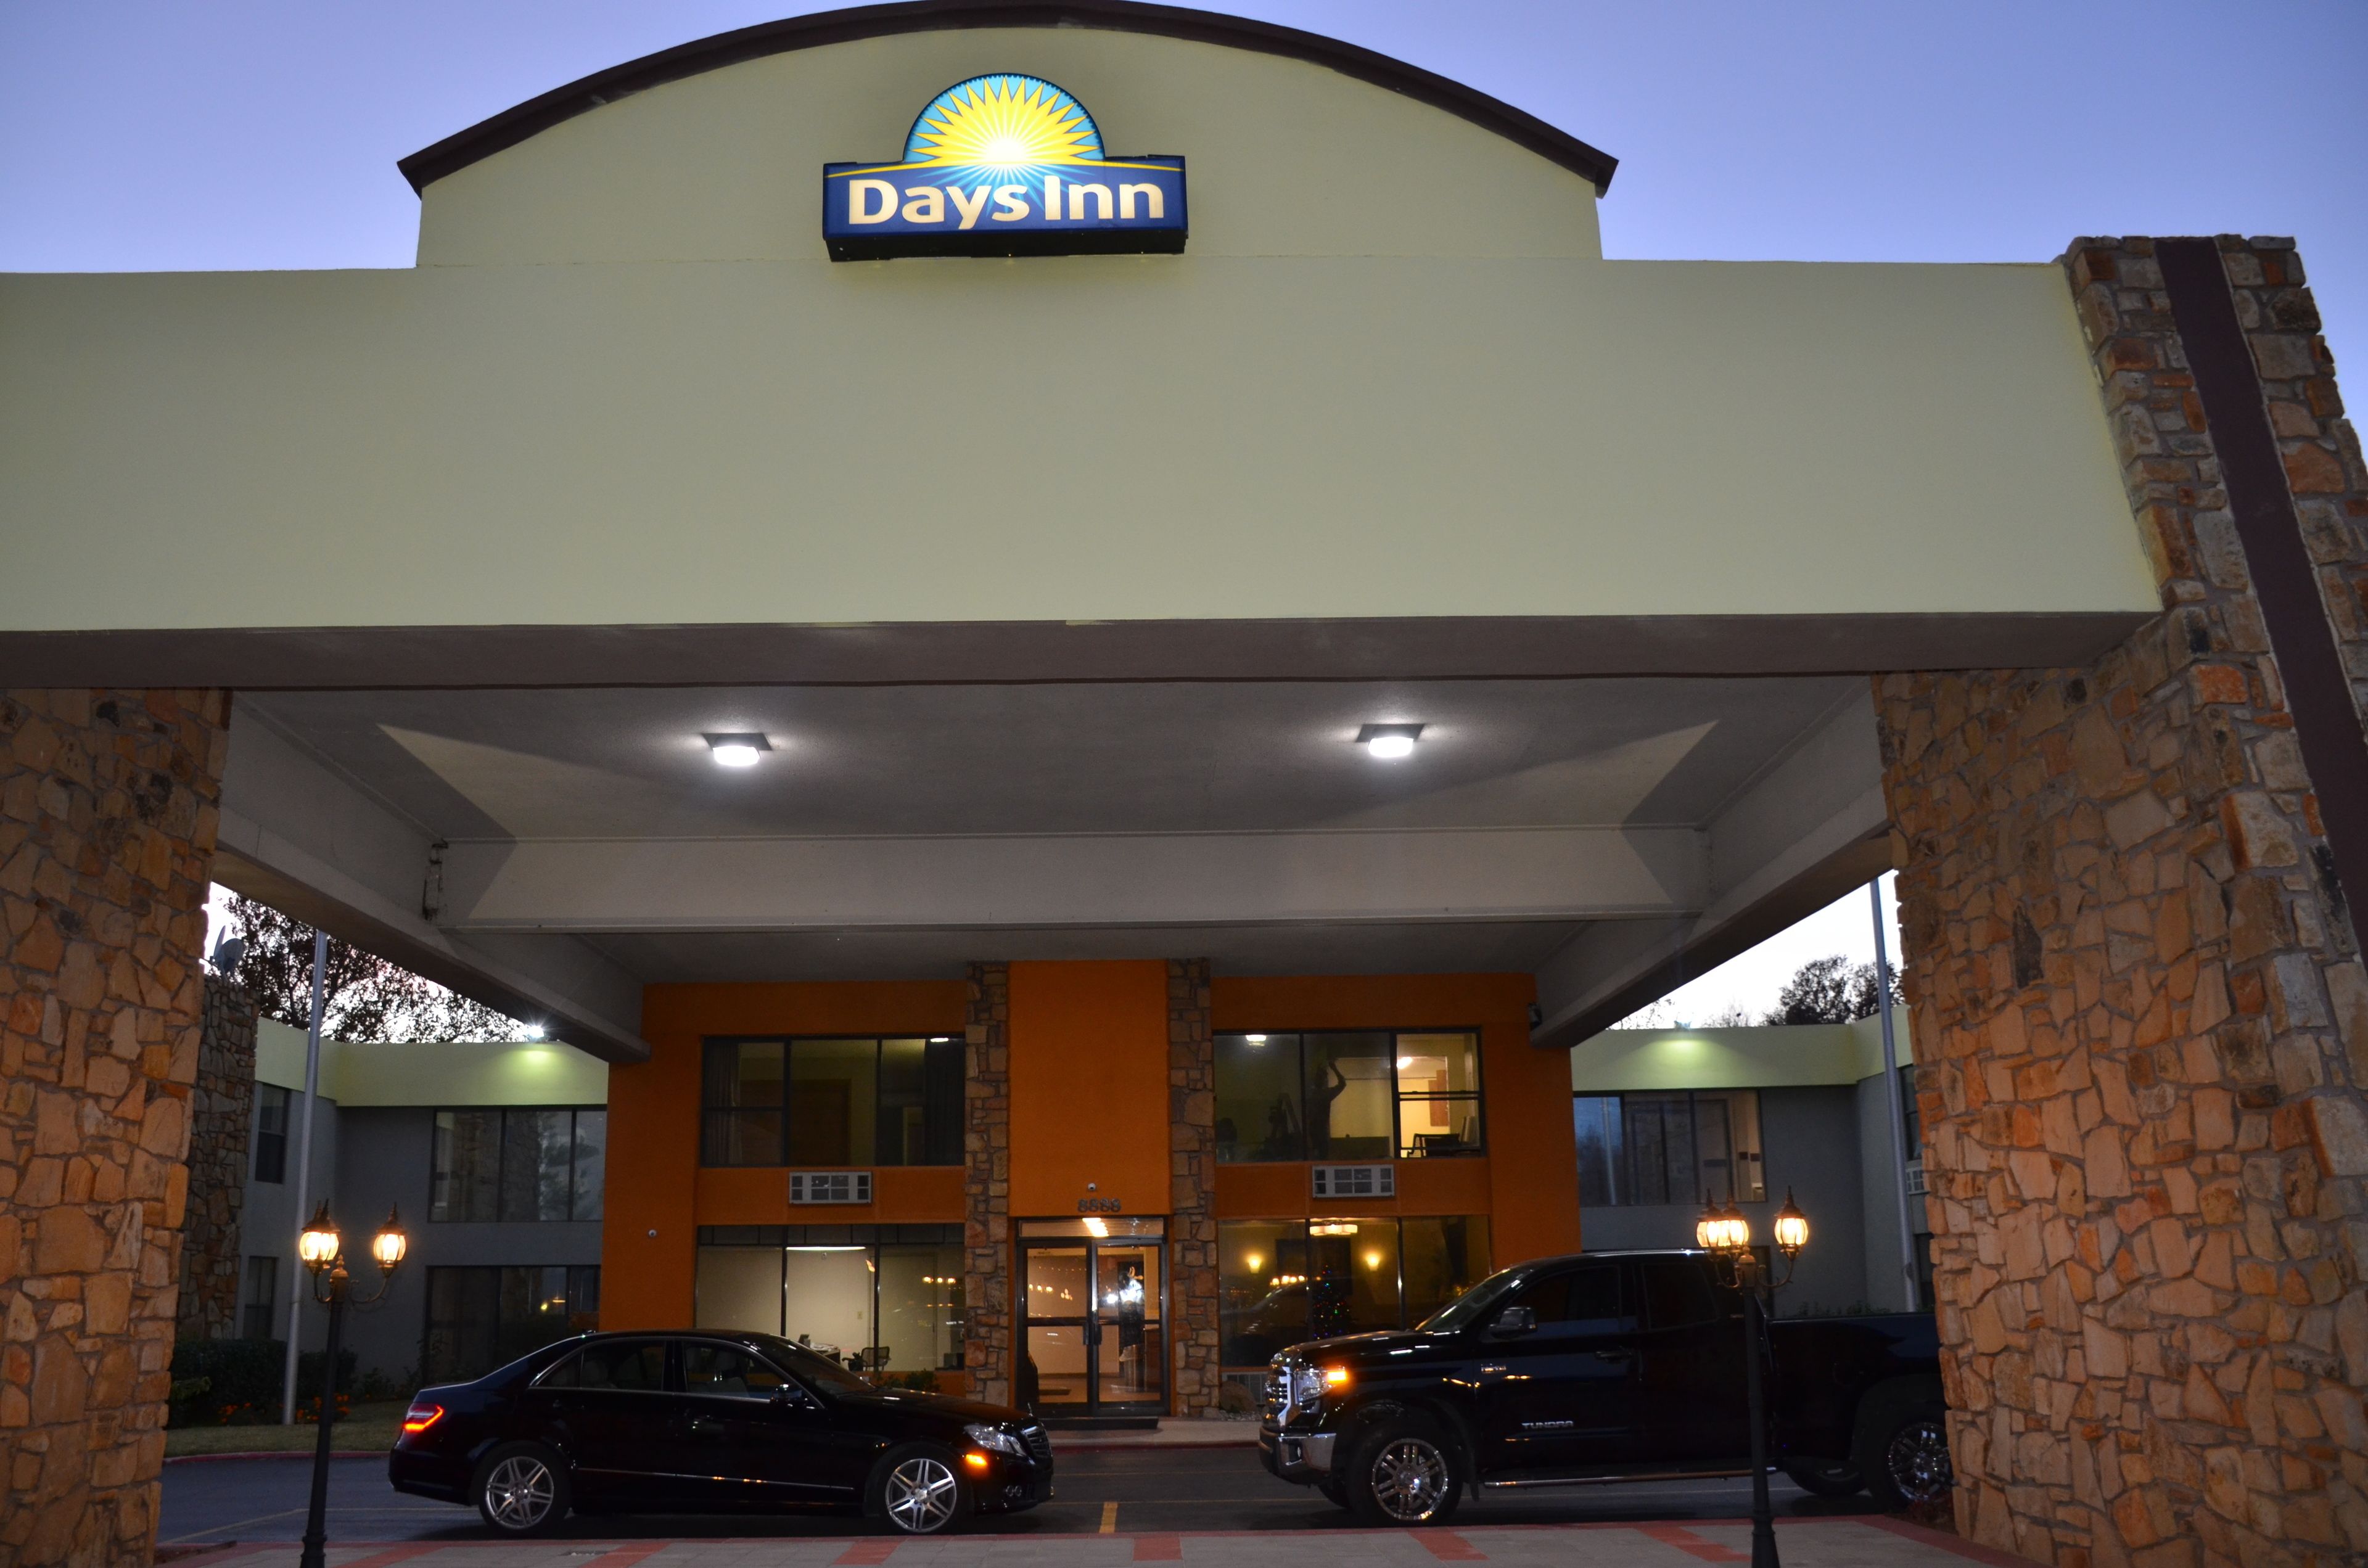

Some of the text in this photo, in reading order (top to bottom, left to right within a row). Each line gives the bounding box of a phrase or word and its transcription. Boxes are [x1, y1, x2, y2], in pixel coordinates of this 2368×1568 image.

[849, 175, 1164, 229] Days Inn
[1521, 1421, 1574, 1429] TUNDRA
